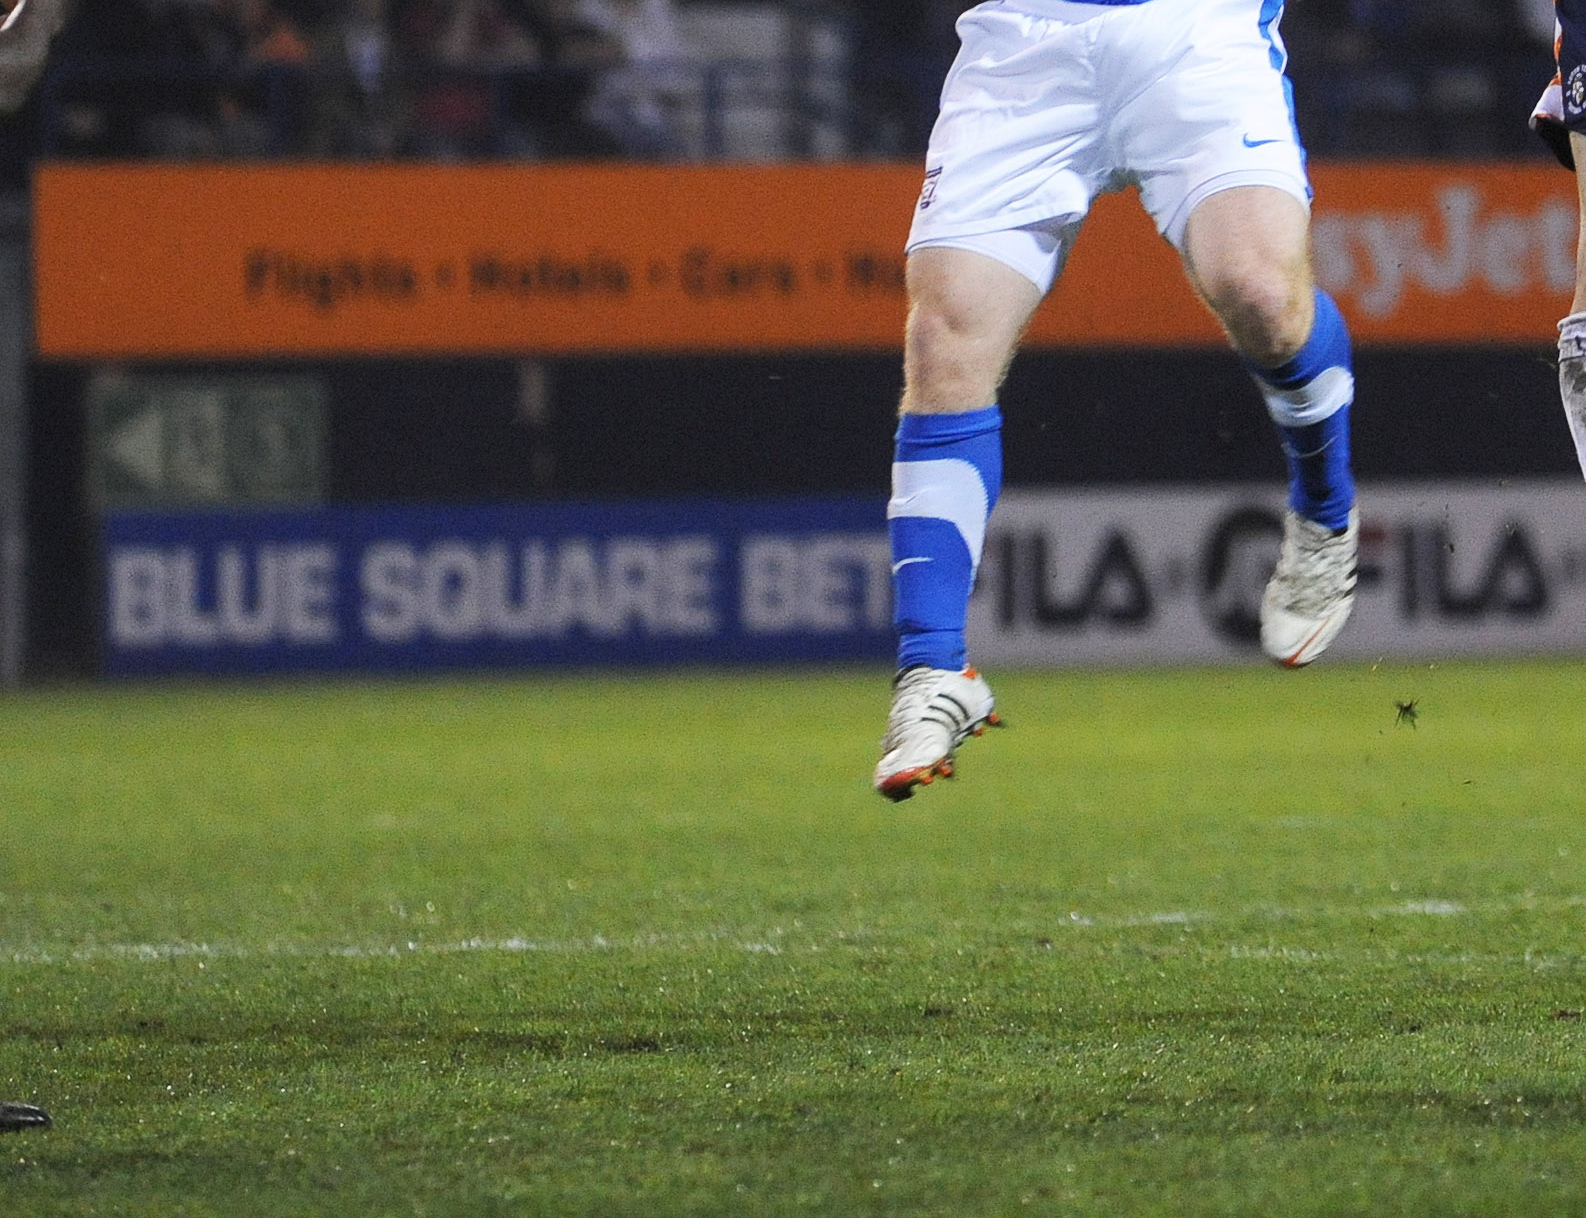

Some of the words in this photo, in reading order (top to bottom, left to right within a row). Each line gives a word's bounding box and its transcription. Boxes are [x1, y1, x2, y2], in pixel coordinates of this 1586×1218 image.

[1309, 184, 1577, 321] syJet
[110, 542, 341, 648] BLUE
[359, 538, 719, 643] SQUARE
[976, 524, 1152, 632] ILA
